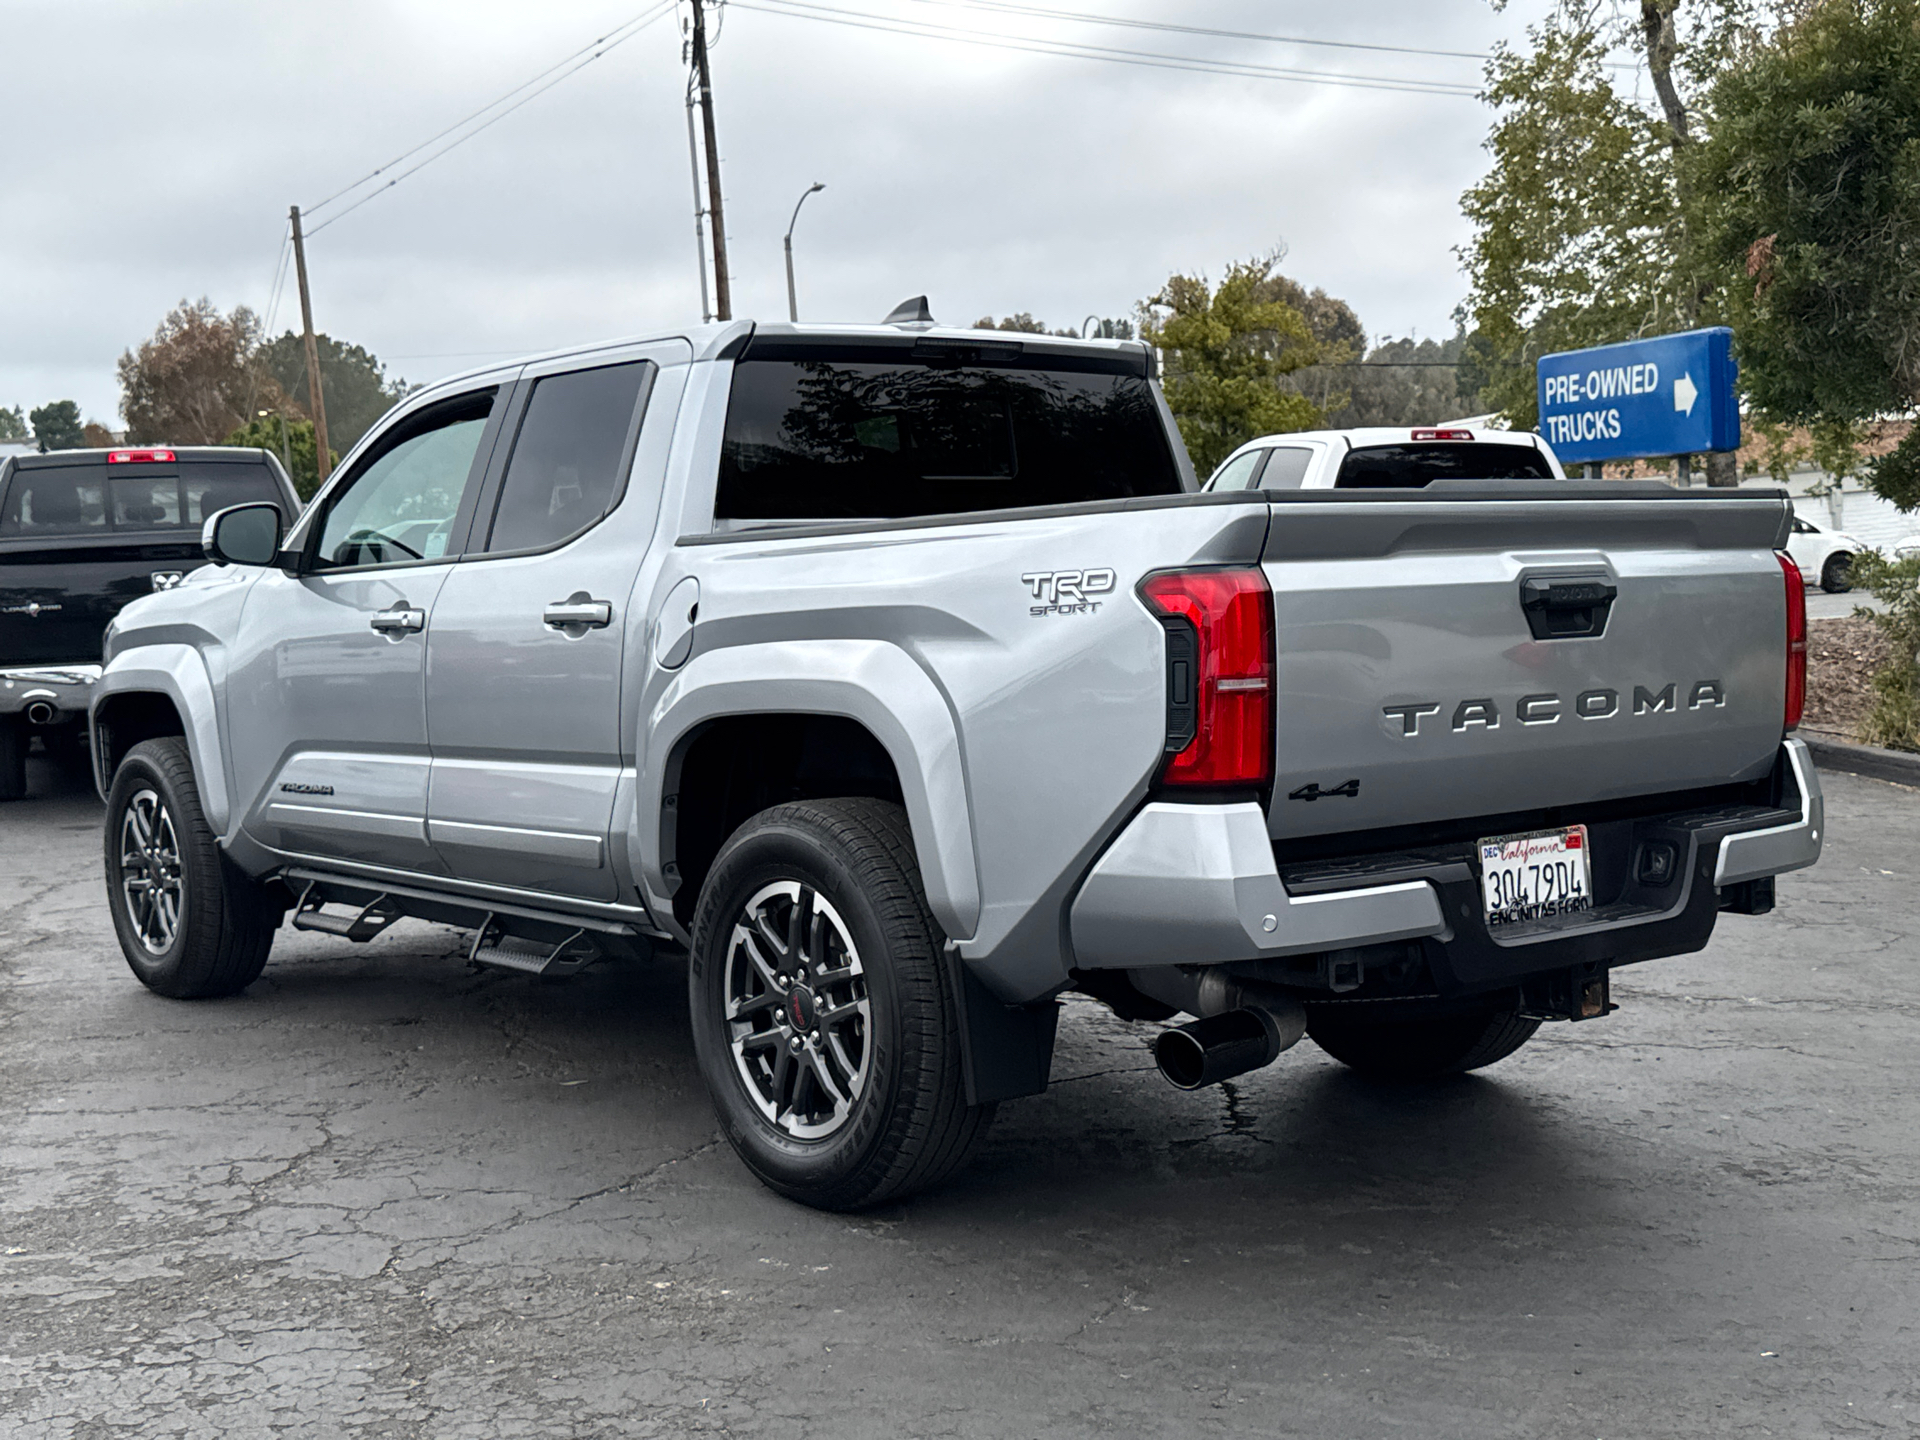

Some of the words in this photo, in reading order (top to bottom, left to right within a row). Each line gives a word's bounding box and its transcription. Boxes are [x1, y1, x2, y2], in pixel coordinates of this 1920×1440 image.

[1545, 362, 1658, 405] PRE-OWNED
[1547, 408, 1621, 444] TRUCKS
[1021, 567, 1117, 604] TRD
[1551, 586, 1597, 600] TOYOTA
[1029, 602, 1103, 617] SPORT
[1383, 679, 1726, 737] TACOMA
[278, 782, 335, 796] TACOMA
[1483, 847, 1498, 859] DEC
[1500, 838, 1567, 864] California
[1489, 860, 1583, 909] 30479D4
[1489, 902, 1557, 925] ENCINITAS
